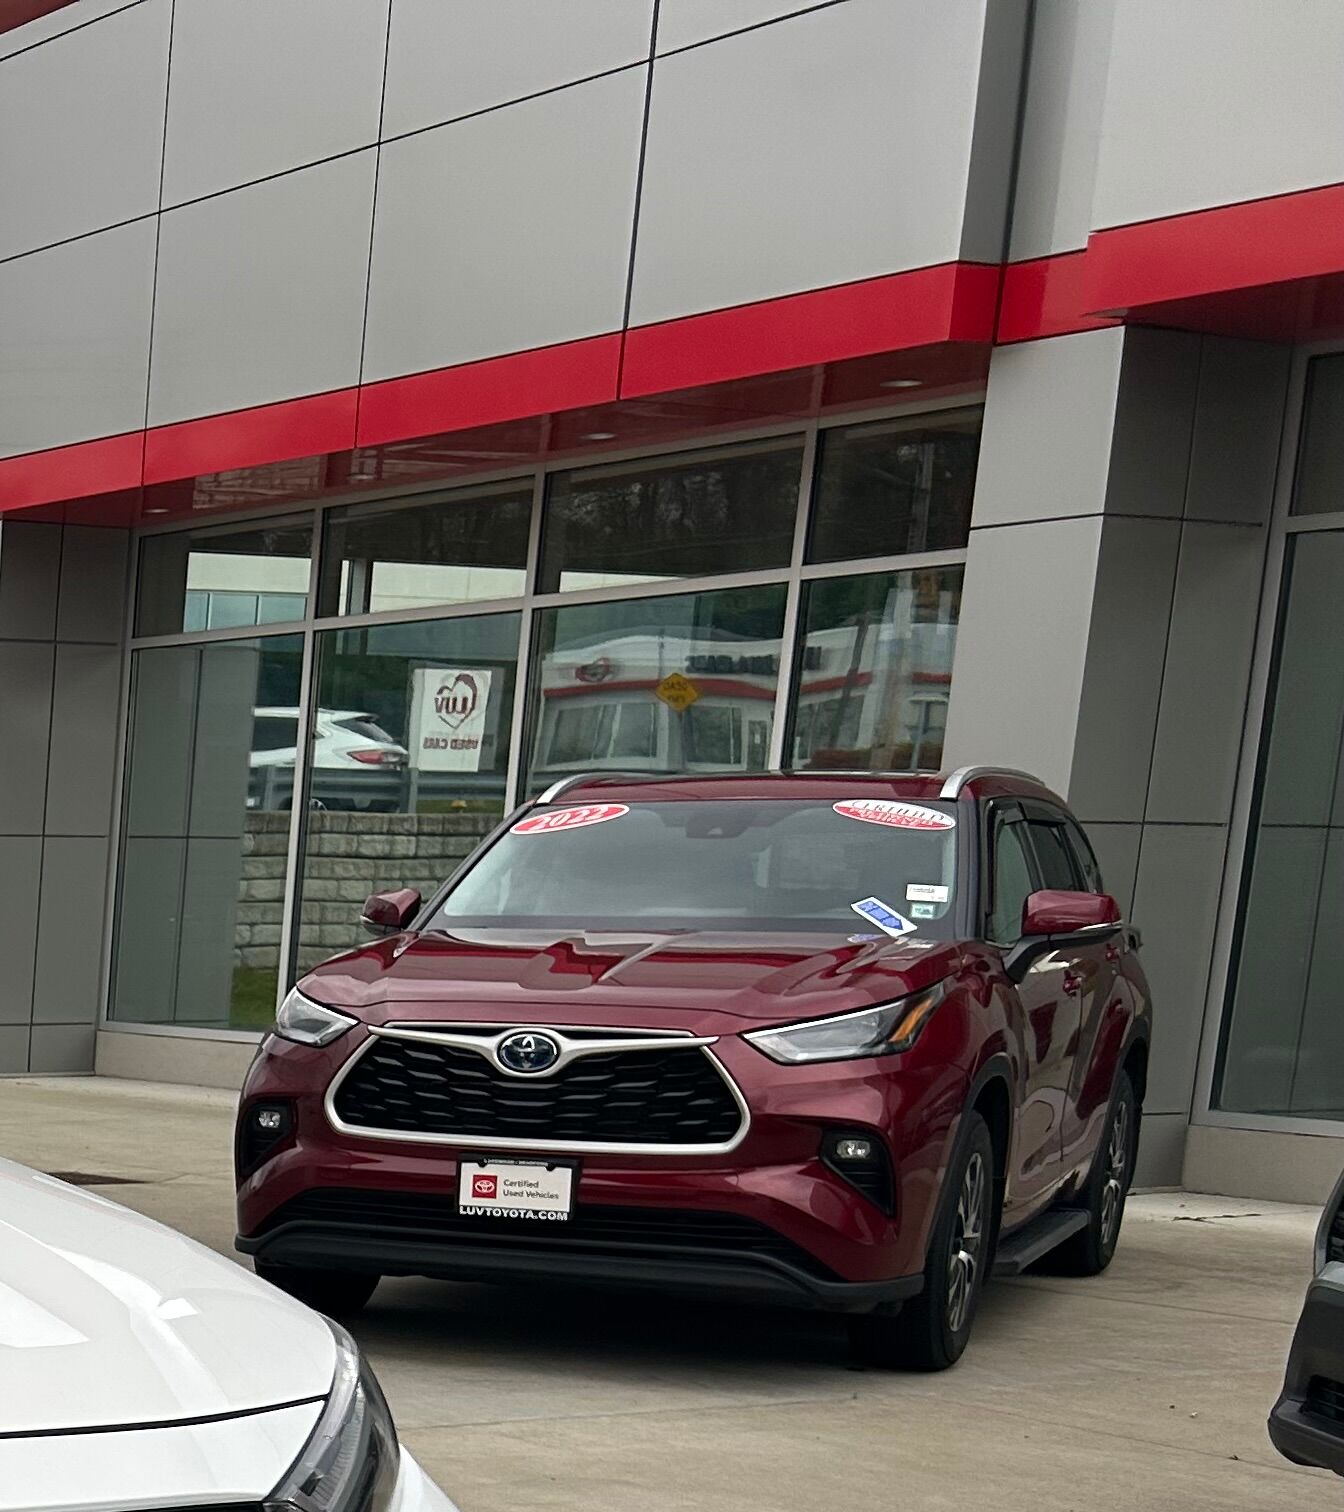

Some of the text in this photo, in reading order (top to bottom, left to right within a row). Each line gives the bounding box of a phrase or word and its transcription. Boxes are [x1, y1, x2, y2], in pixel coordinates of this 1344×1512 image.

[527, 805, 609, 831] 2022
[503, 1179, 539, 1189] Certified
[503, 1190, 559, 1200] Used Vehicles
[459, 1206, 568, 1221] LUVTOYOTA.COM
